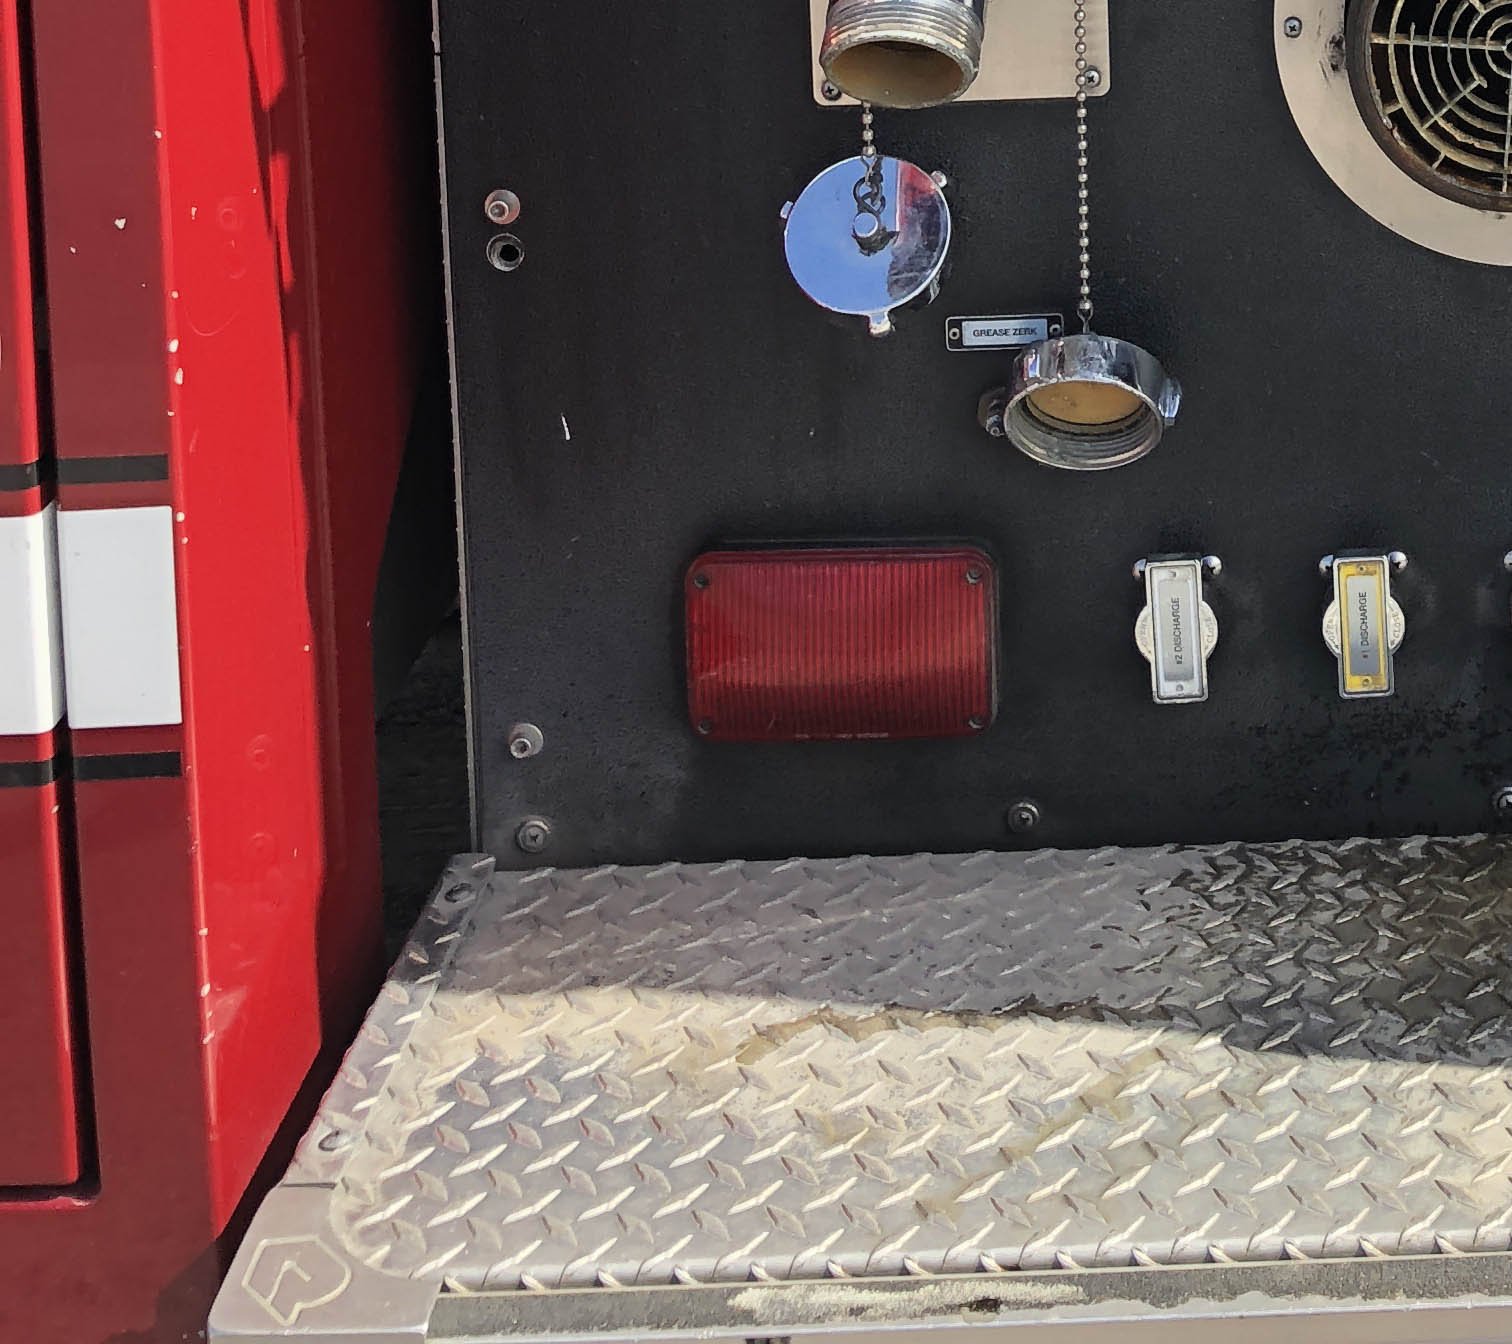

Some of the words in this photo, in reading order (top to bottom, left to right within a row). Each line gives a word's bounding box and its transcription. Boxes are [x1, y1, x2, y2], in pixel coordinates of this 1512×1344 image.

[973, 328, 1010, 338] GREASE
[1013, 327, 1037, 336] ZERK
[1171, 597, 1182, 653] DISCHARGE
[1363, 647, 1369, 659] #1
[1176, 654, 1183, 665] #2
